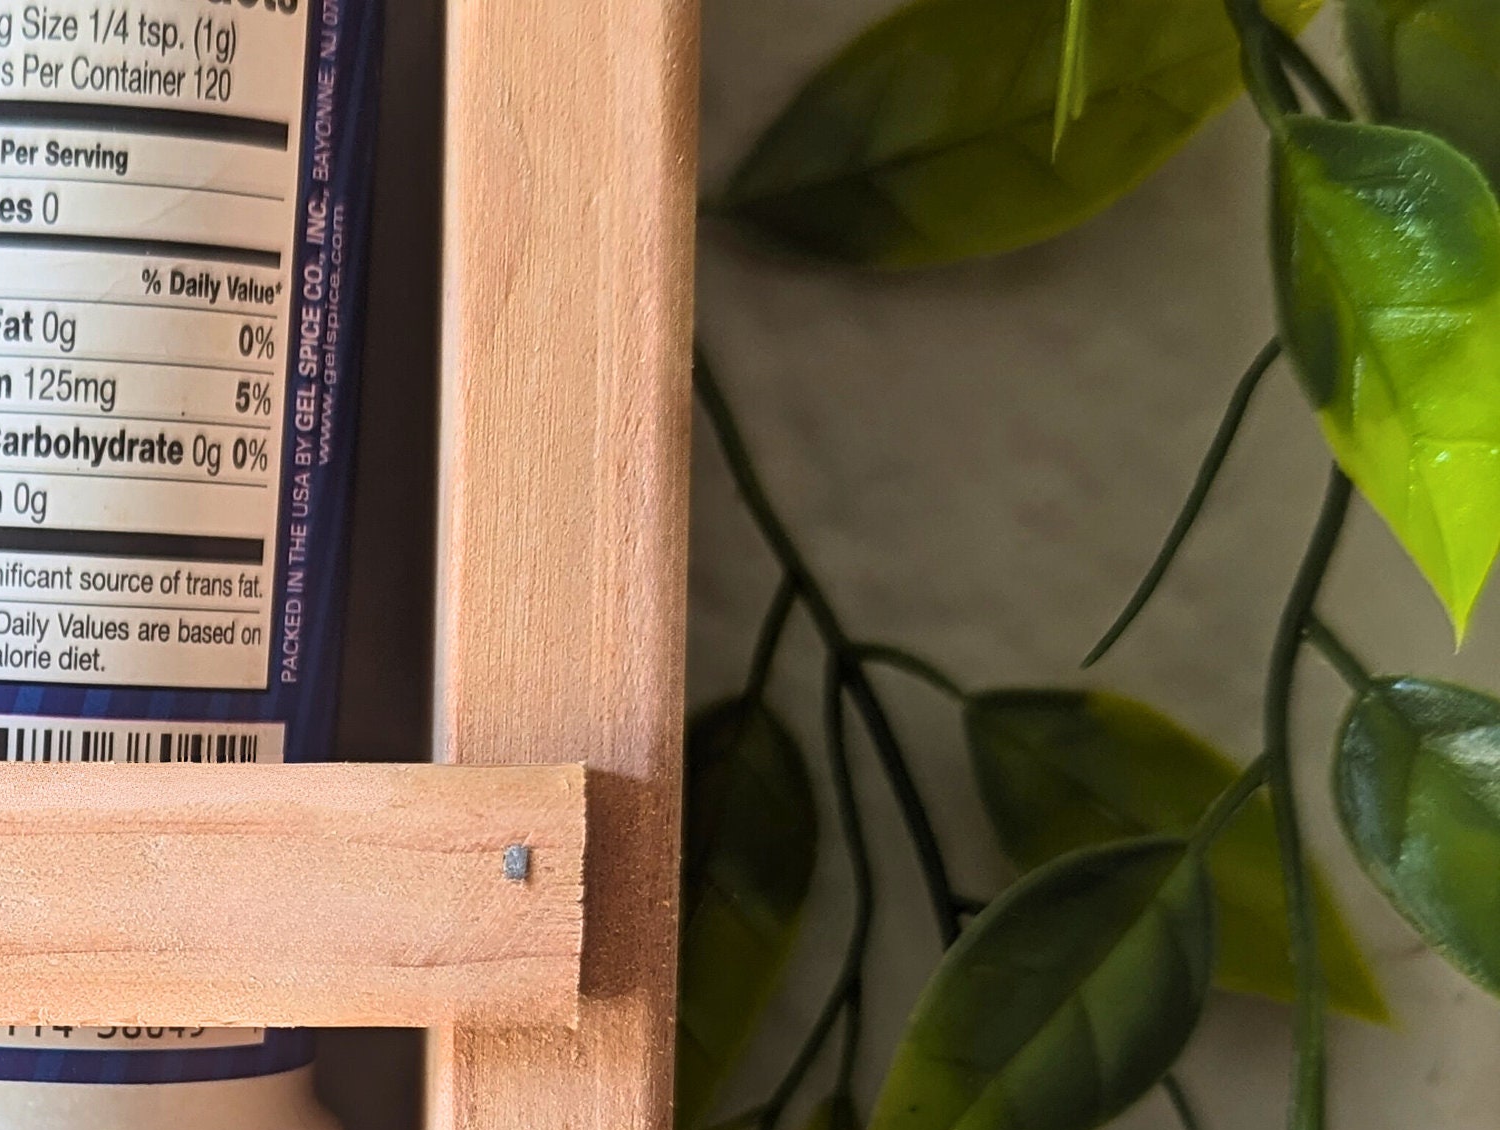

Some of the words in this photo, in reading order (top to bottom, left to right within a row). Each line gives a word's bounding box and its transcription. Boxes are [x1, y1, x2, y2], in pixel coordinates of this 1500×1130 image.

[22, 8, 78, 41] Size
[90, 10, 129, 44] 1/4
[139, 18, 184, 60] tsp.
[194, 21, 236, 63] (1g)
[23, 55, 63, 88] Per
[71, 56, 184, 97] Container
[194, 68, 231, 101] 120
[1, 143, 37, 165] Per
[46, 141, 128, 175] Serving
[42, 192, 58, 225] 0
[142, 271, 160, 294] %
[170, 271, 220, 303] Daily
[304, 253, 325, 300] CO.,
[42, 310, 76, 352] 0g
[238, 325, 274, 358] 0%
[298, 304, 322, 376] SPICE
[319, 204, 345, 465] www.gelspice.com
[24, 366, 116, 411] 125mg
[235, 382, 271, 415] 5%
[296, 384, 316, 430] GEL
[193, 438, 221, 476] 0g
[233, 439, 267, 471] 0%
[295, 440, 312, 467] BY
[14, 482, 47, 522] 0g
[292, 472, 310, 517] USA
[289, 524, 307, 566] THE
[80, 566, 153, 593] source
[160, 571, 180, 594] of
[186, 572, 232, 597] trans
[238, 575, 263, 599] fat.
[287, 571, 303, 595] IN
[58, 614, 129, 641] Values
[137, 622, 170, 641] are
[178, 619, 234, 645] based
[241, 625, 261, 645] on
[282, 599, 301, 683] PACKED
[58, 647, 105, 671] diet.
